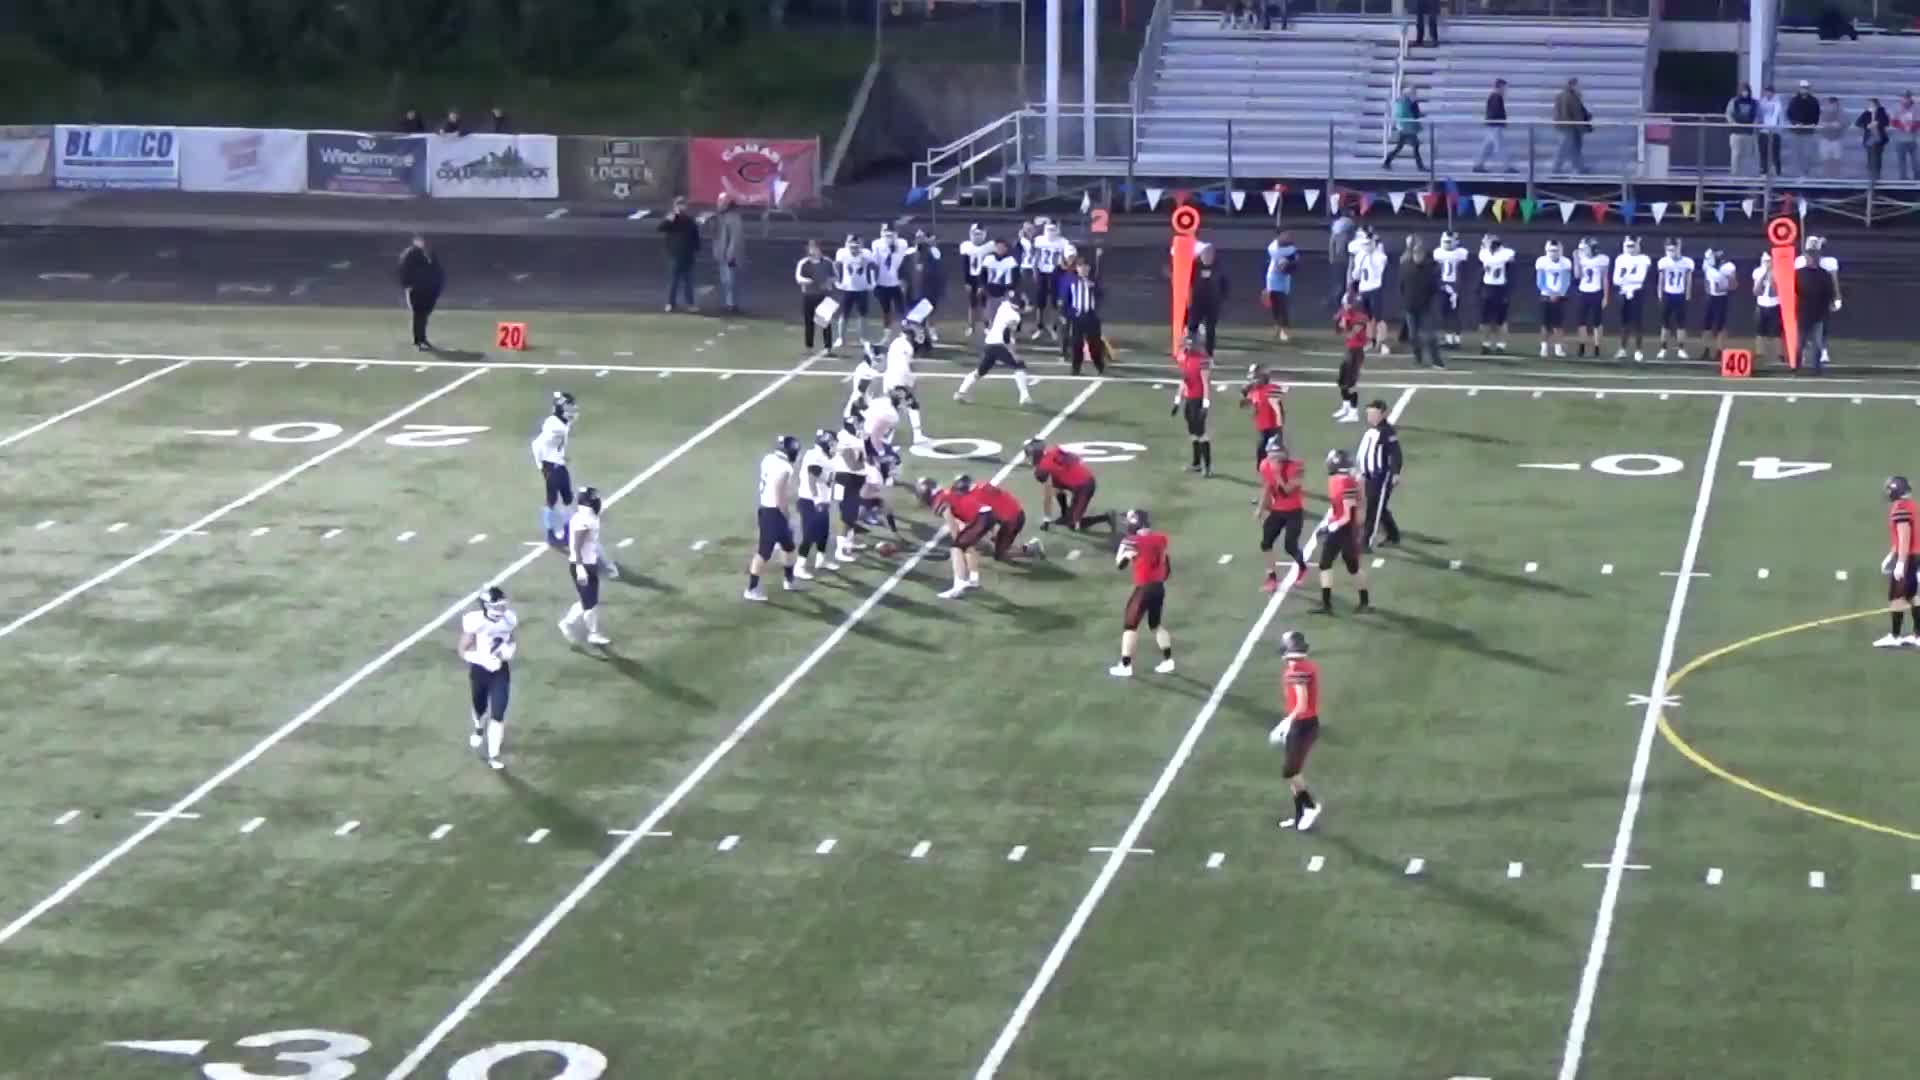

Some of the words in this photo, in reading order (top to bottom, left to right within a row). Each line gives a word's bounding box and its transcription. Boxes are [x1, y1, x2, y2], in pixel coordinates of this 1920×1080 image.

[1090, 208, 1110, 233] 2
[498, 325, 521, 348] 20
[1725, 353, 1749, 375] 40
